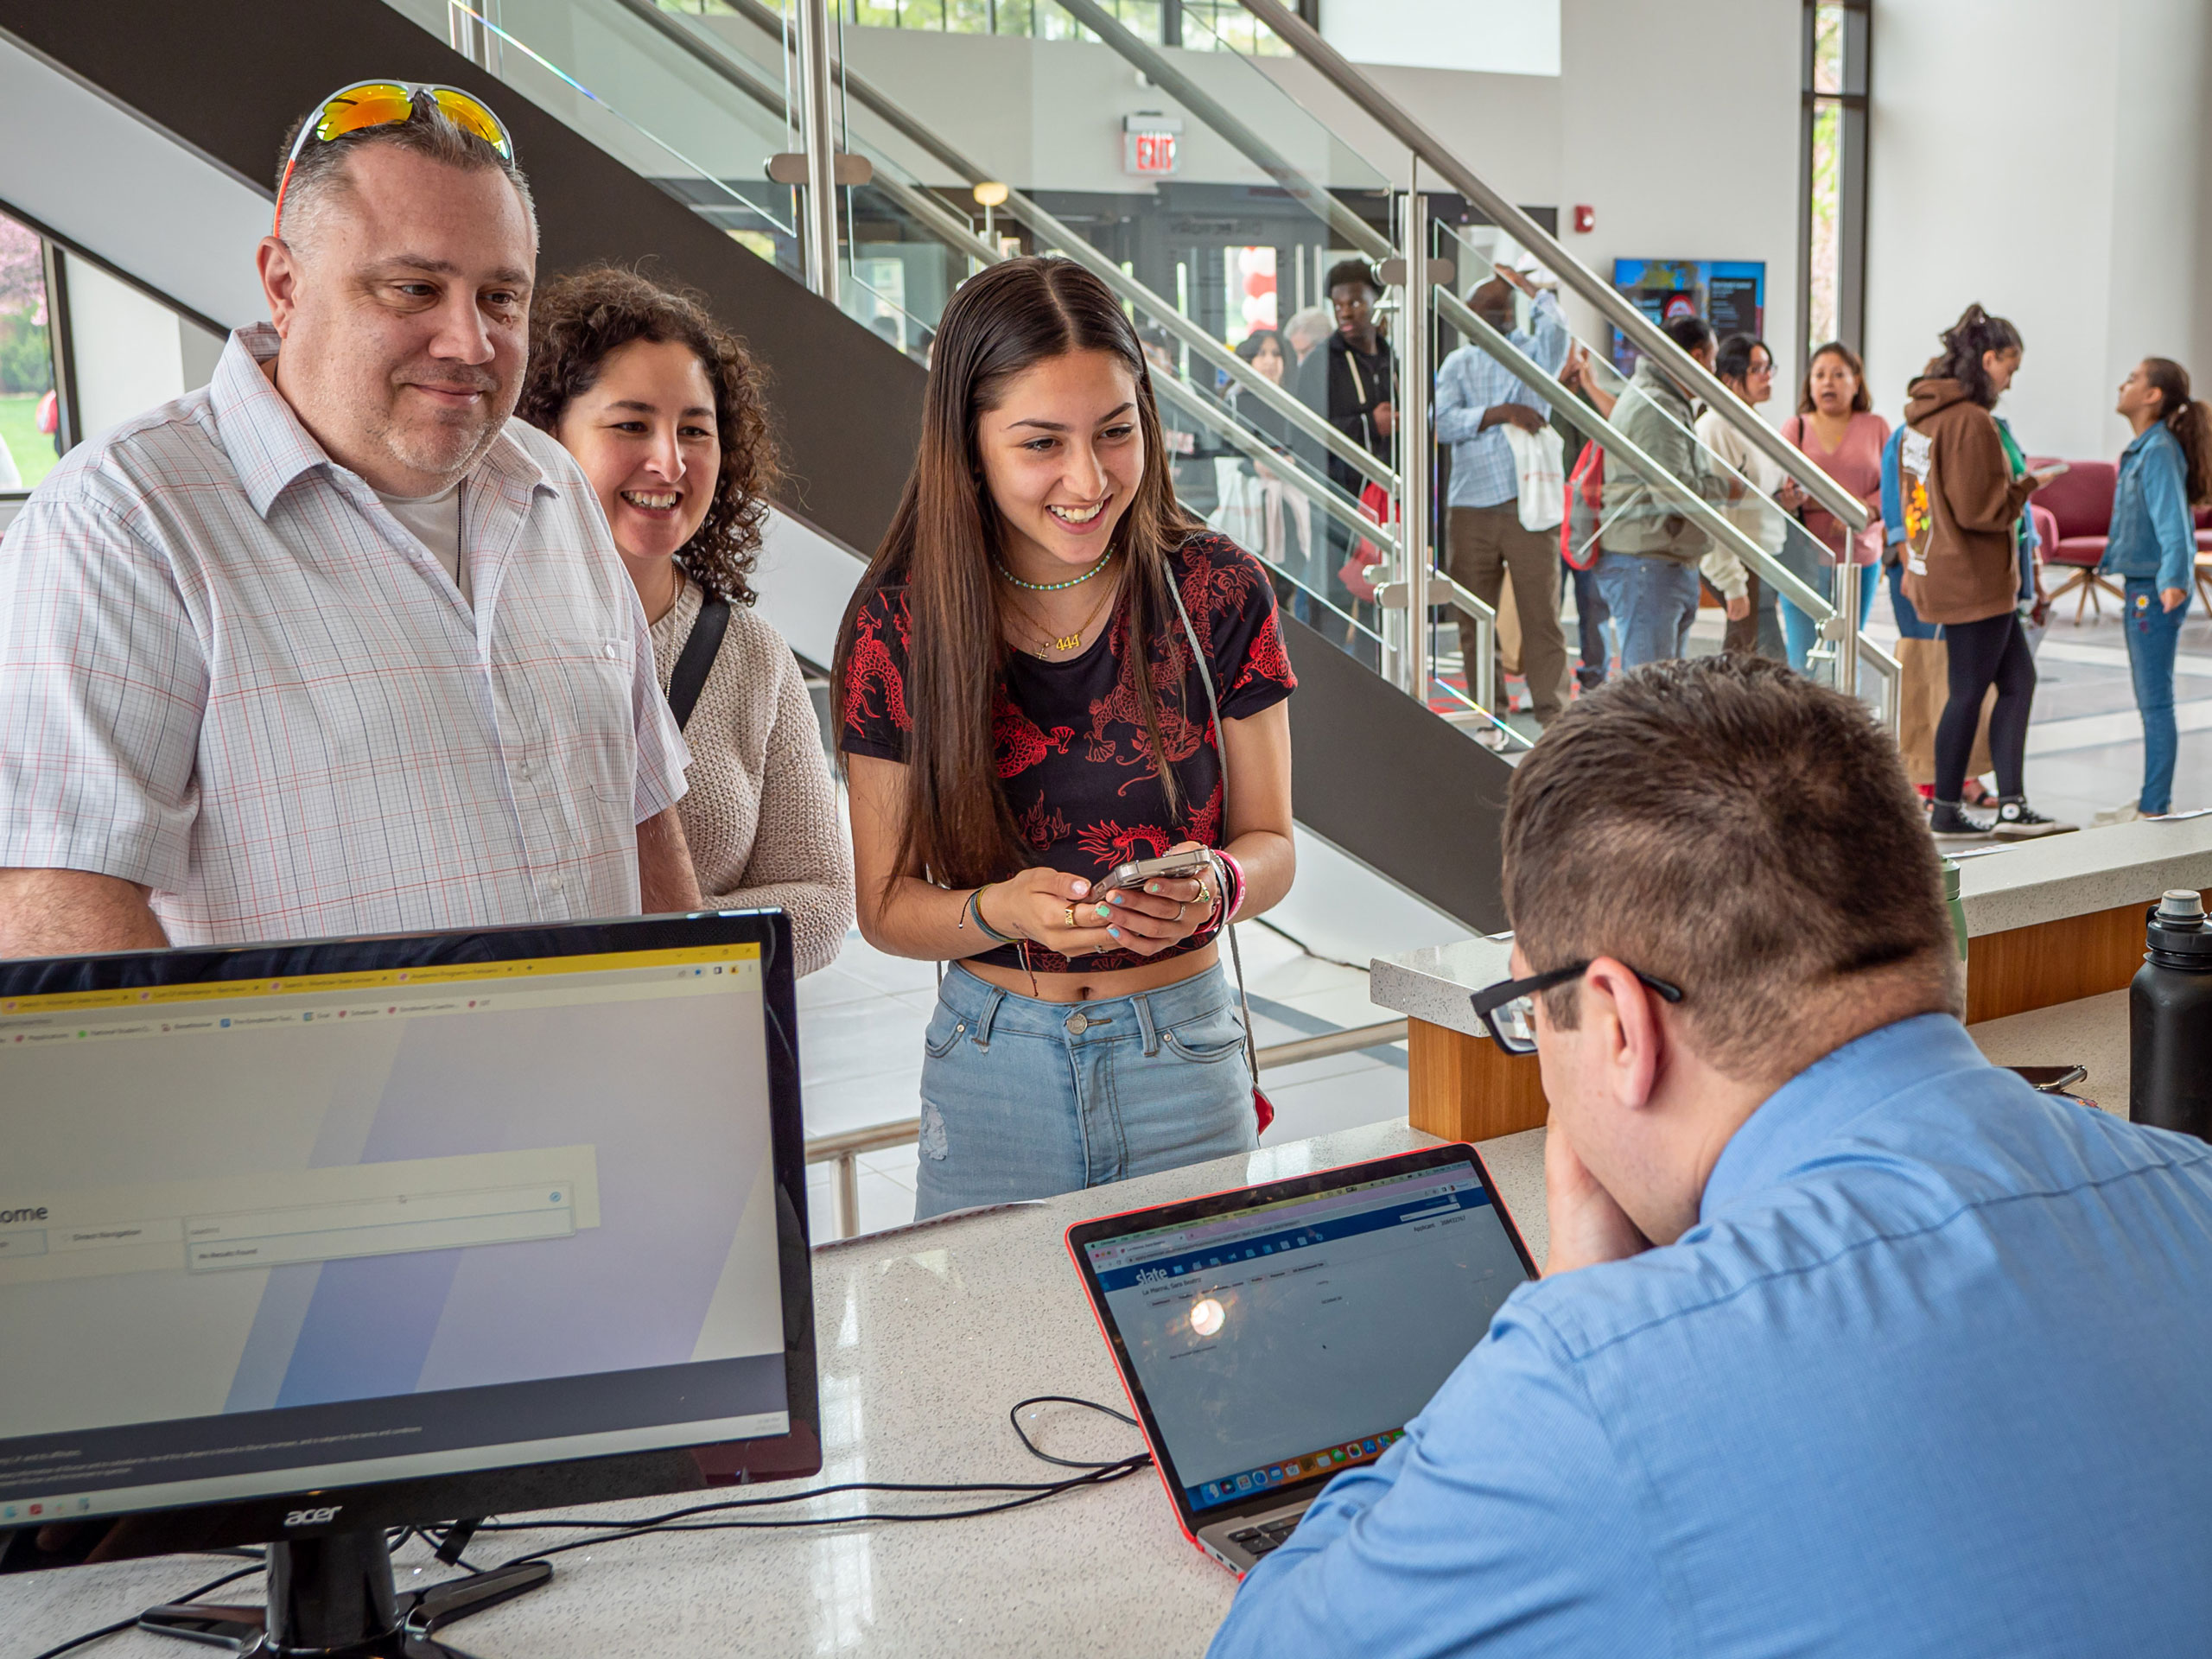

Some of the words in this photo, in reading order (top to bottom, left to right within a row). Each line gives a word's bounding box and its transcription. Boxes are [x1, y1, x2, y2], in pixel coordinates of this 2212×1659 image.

[1135, 135, 1176, 170] EXIT
[1056, 632, 1080, 652] 444
[0, 1206, 48, 1224] ome
[1135, 1268, 1169, 1286] slate
[283, 1505, 343, 1527] acer
